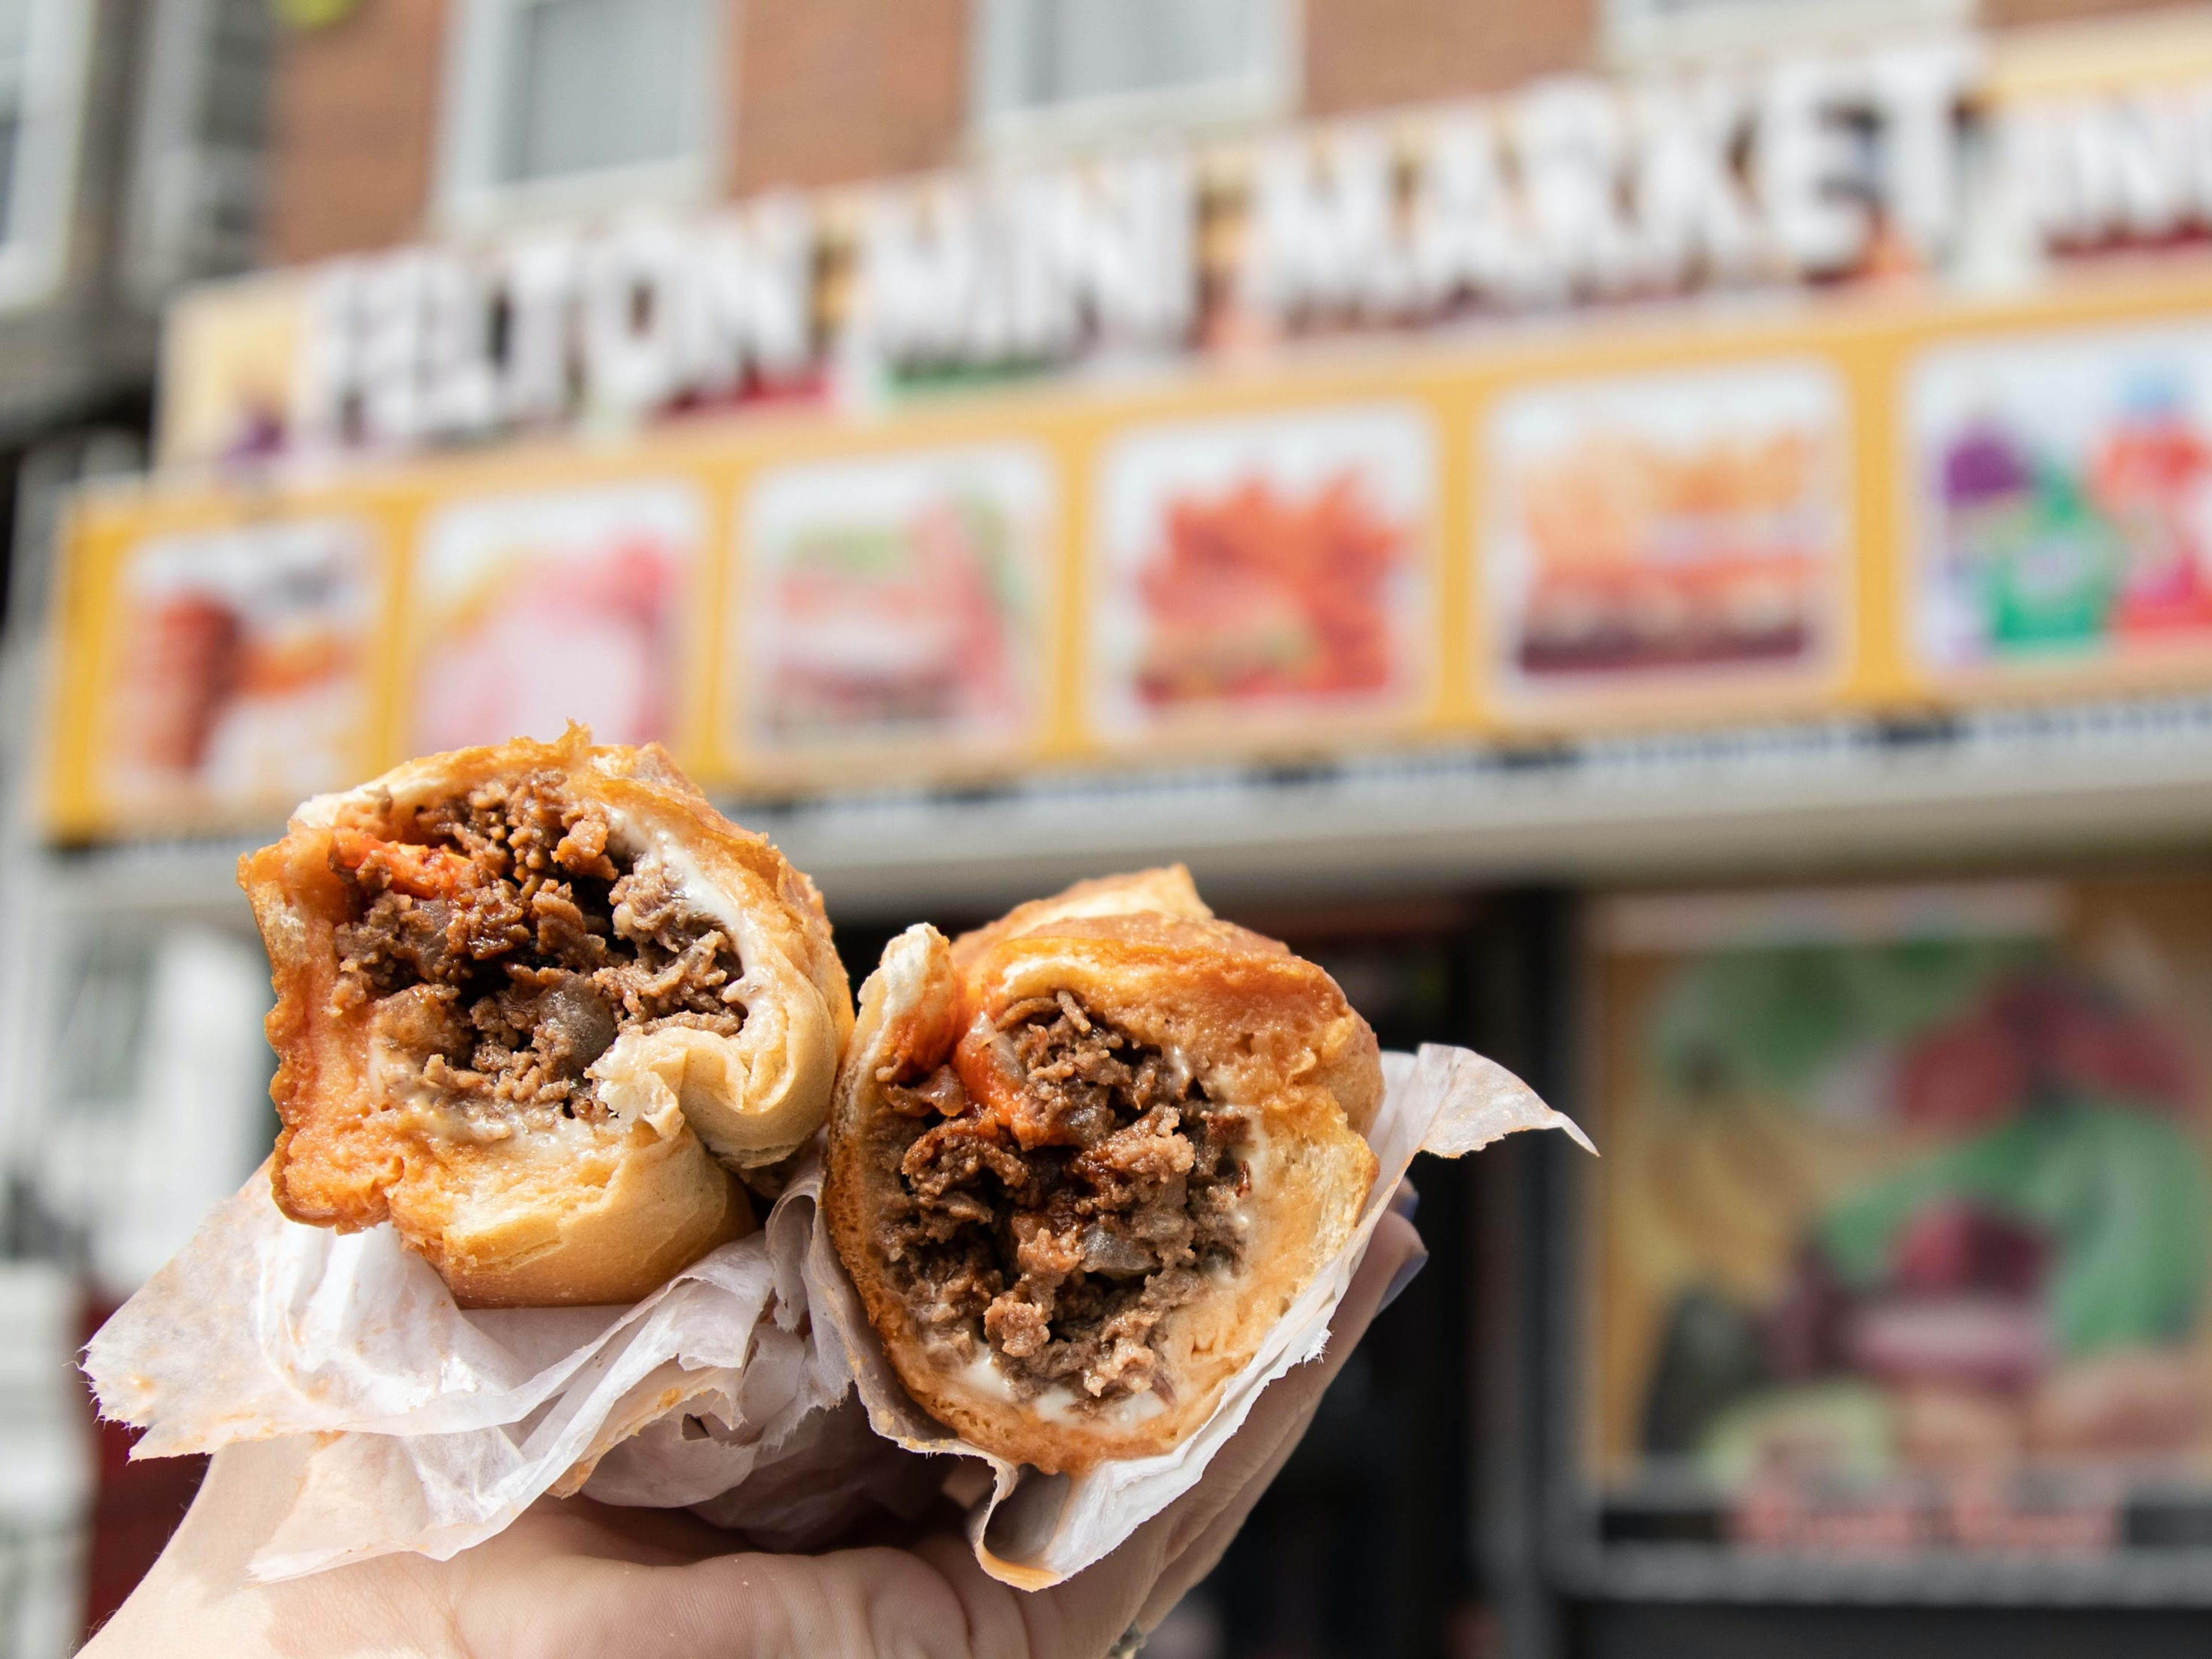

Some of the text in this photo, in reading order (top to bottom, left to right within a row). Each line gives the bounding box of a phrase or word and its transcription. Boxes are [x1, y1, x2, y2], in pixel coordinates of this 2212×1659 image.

[314, 193, 815, 431] FELTON
[858, 152, 1194, 366] MINI
[1244, 47, 1979, 305] MARKET
